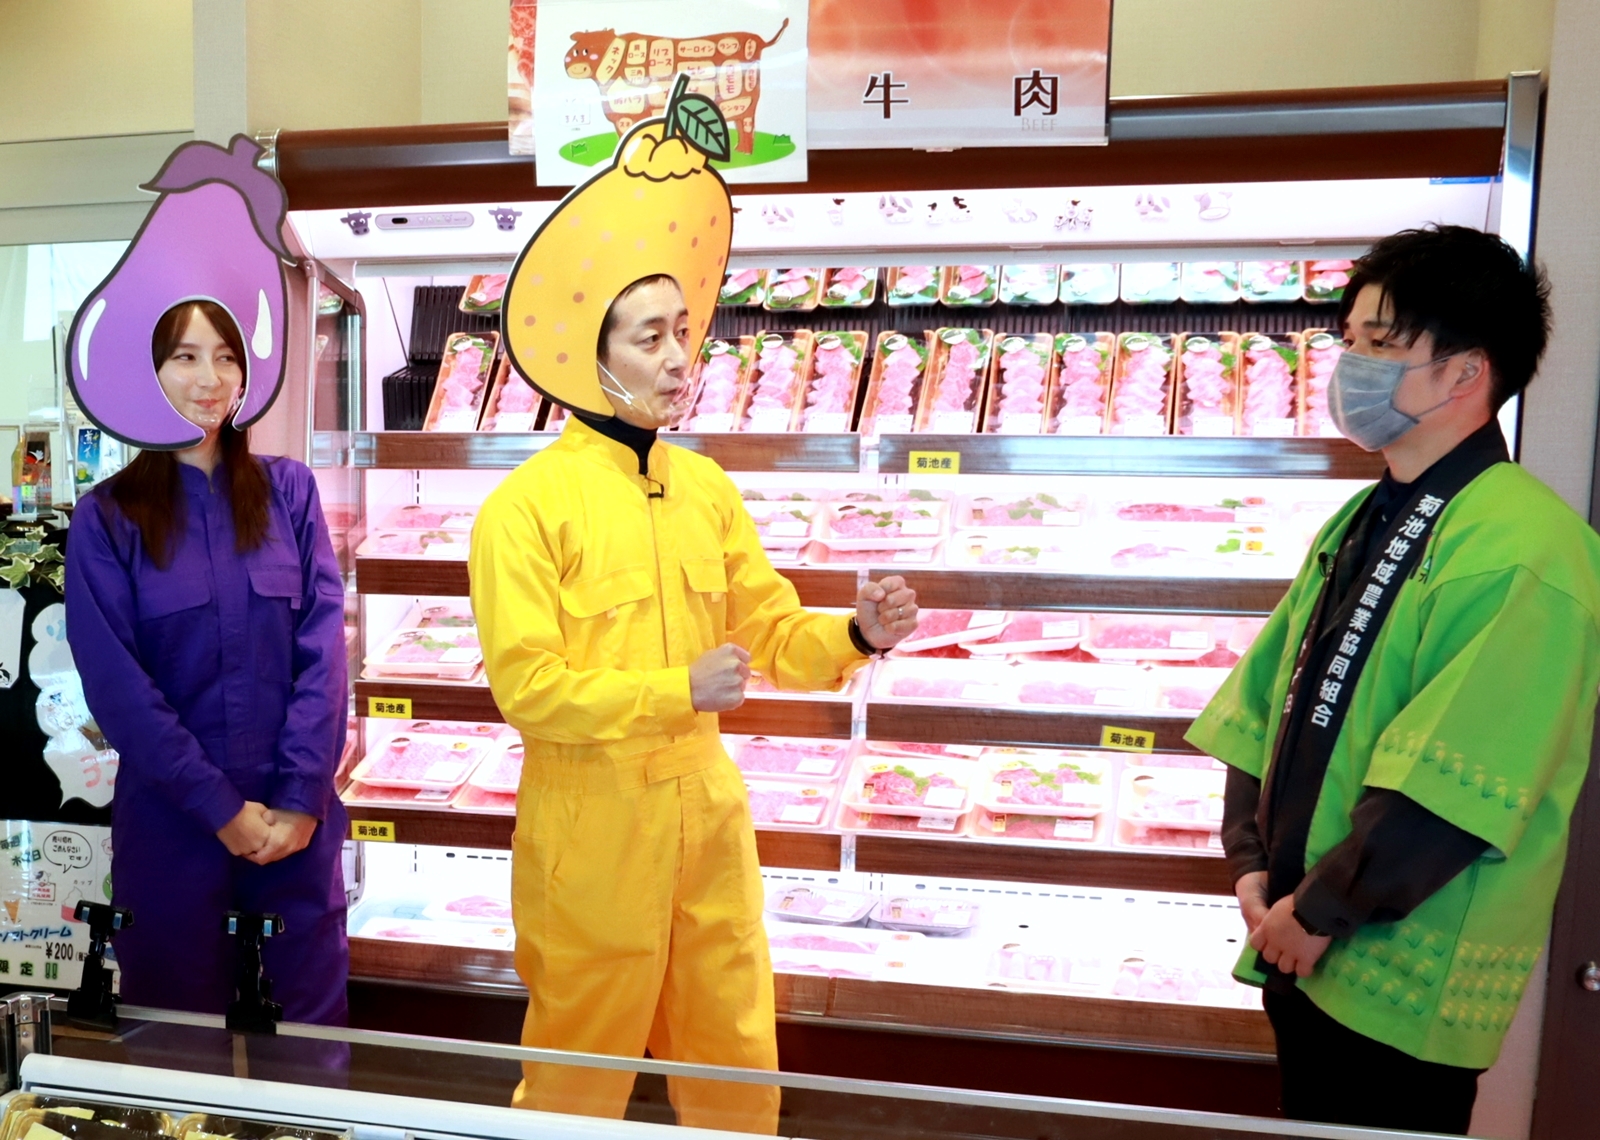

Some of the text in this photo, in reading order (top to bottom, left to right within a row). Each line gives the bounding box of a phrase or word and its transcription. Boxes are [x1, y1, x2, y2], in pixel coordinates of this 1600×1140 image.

[628, 51, 646, 59] ロース
[680, 45, 714, 54] サーロイン
[605, 46, 620, 74] ネック
[649, 58, 672, 67] ロース
[1021, 117, 1058, 132] BEEF
[916, 457, 953, 469] 菊池産
[1311, 494, 1445, 728] 菊池地域農業協同組合
[375, 702, 406, 714] 菊池産
[1110, 732, 1147, 748] 菊池産
[357, 825, 389, 837] 菊池産
[45, 941, 74, 960] ¥200
